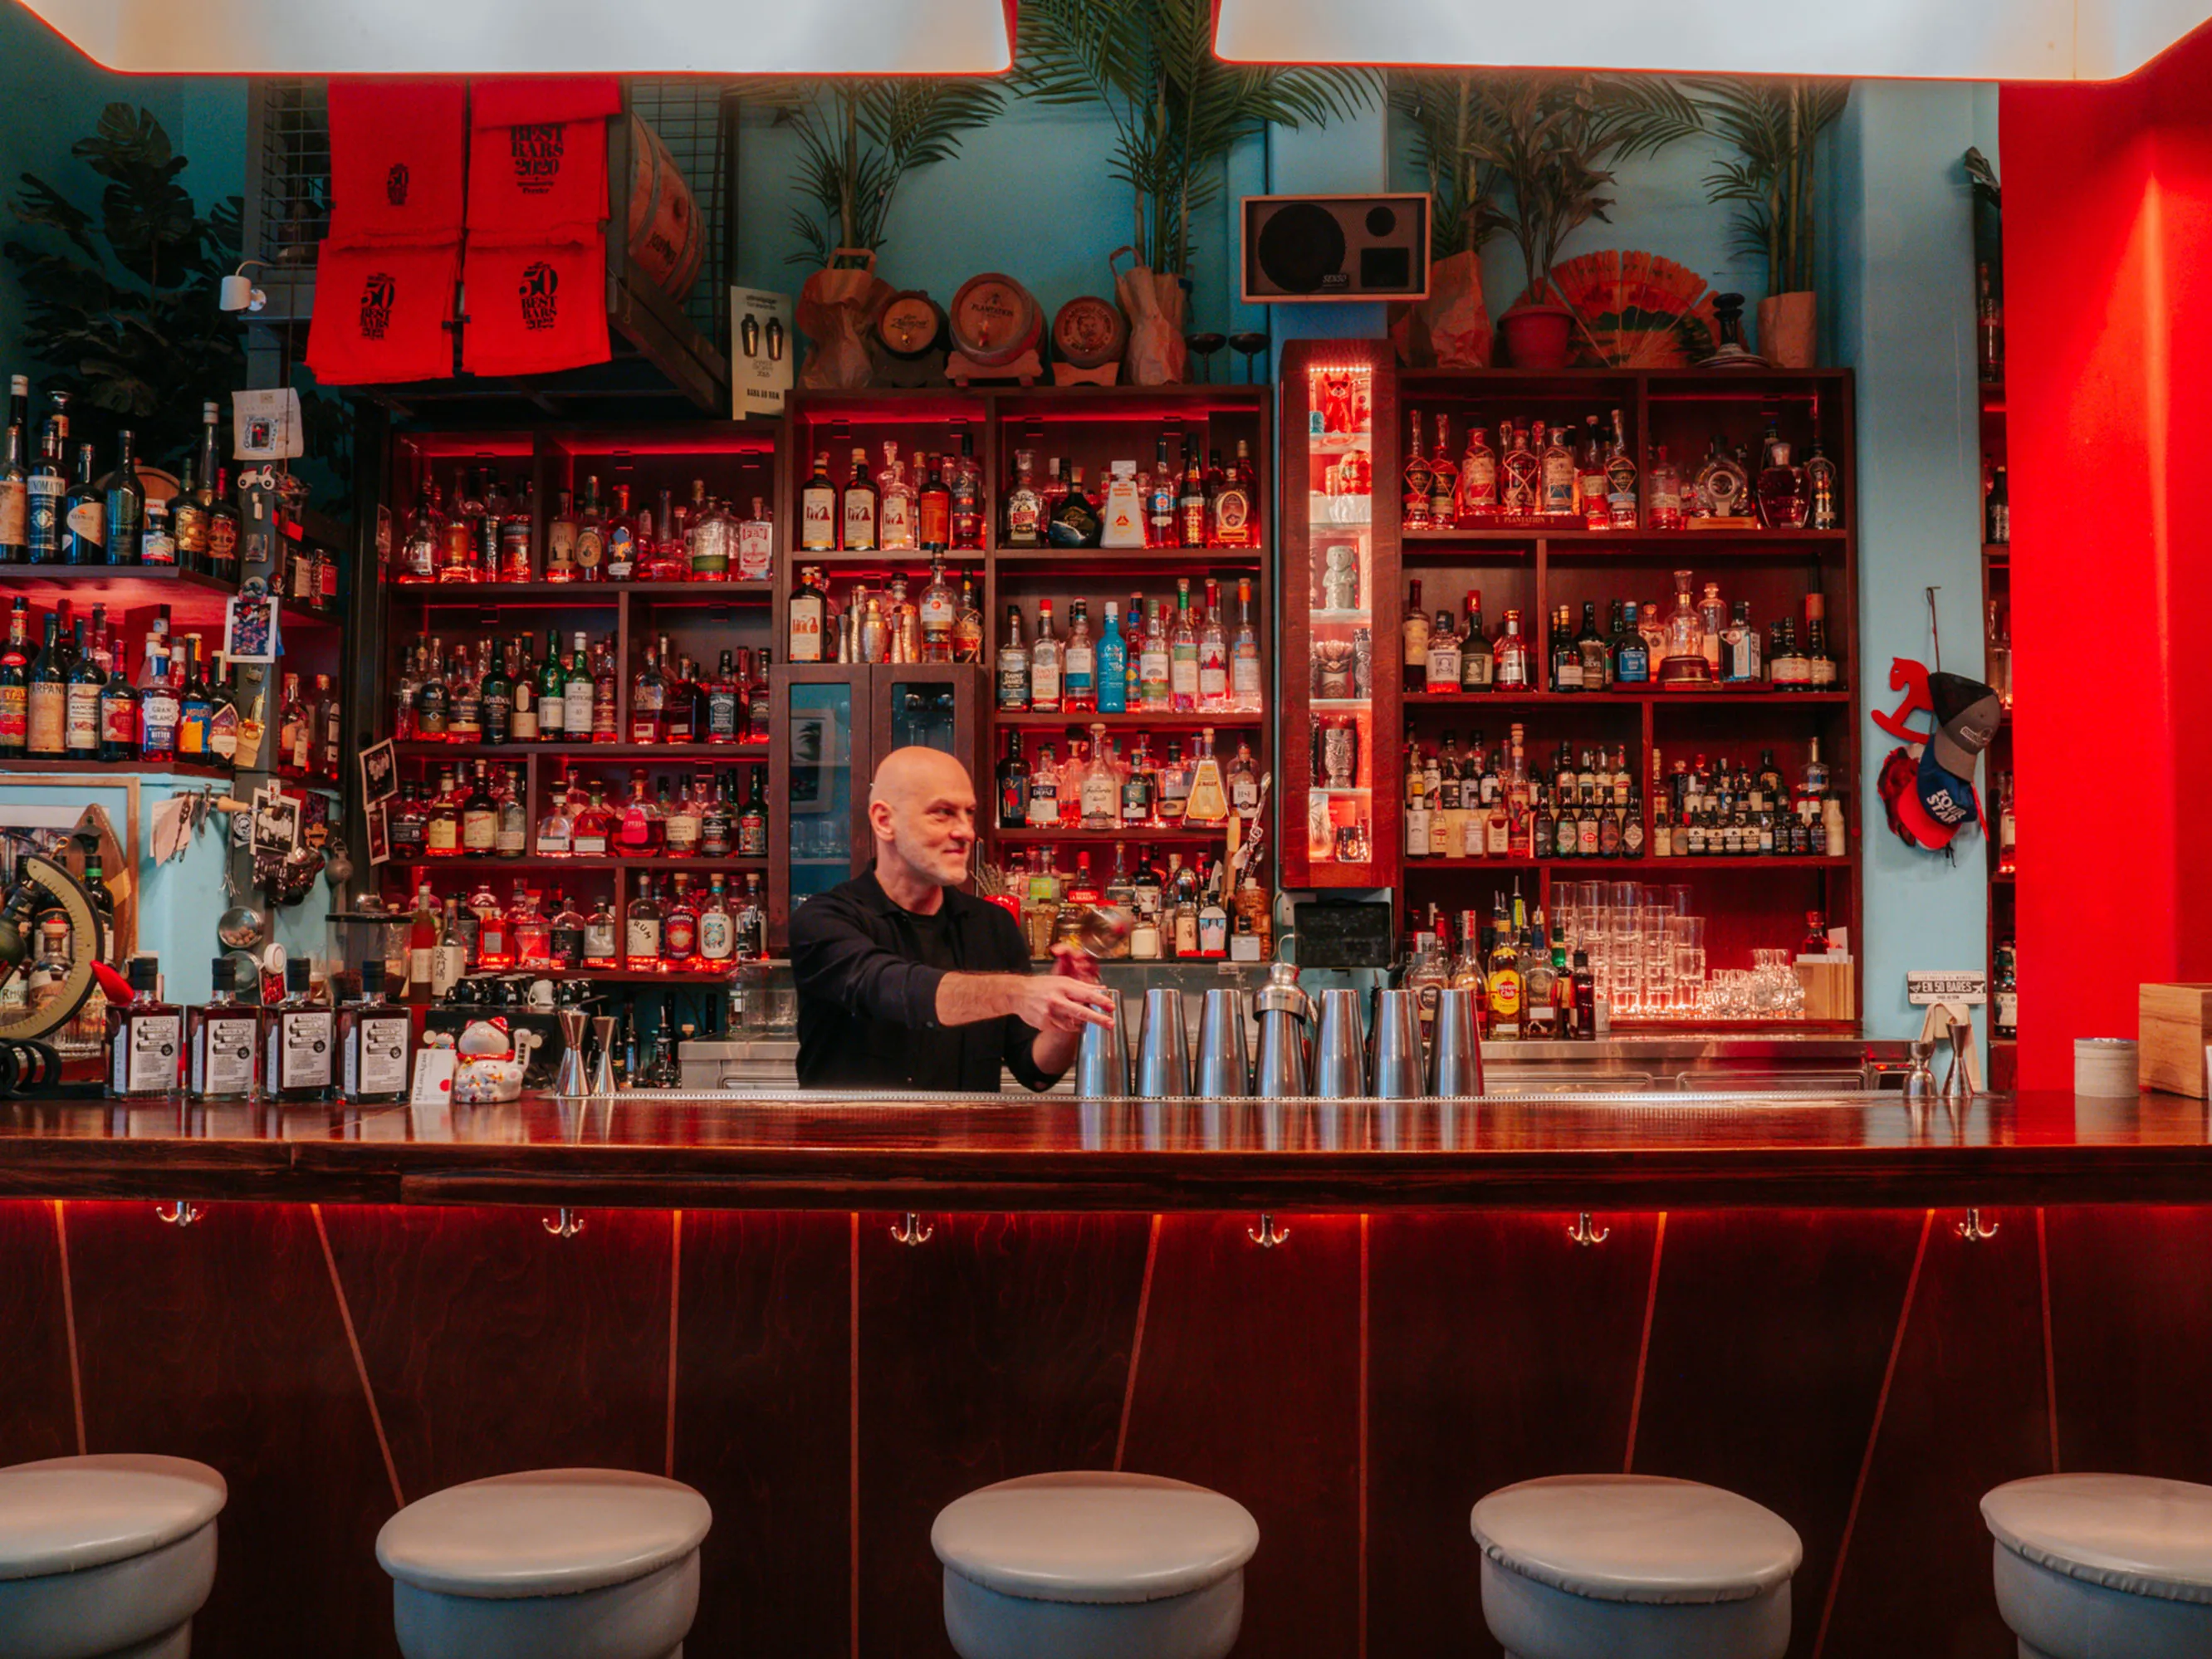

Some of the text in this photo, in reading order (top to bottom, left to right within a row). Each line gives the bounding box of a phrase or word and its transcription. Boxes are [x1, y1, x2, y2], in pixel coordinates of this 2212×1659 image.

[511, 142, 564, 158] BARS
[515, 158, 560, 176] 2020
[519, 269, 558, 296] 50
[360, 281, 395, 309] 50
[521, 296, 557, 308] BEST
[522, 307, 557, 320] BARS
[1926, 794, 1957, 823] STAR
[1936, 789, 1966, 819] FOUR
[634, 921, 651, 939] RUM
[1922, 981, 1971, 992] EN 50 BARES
